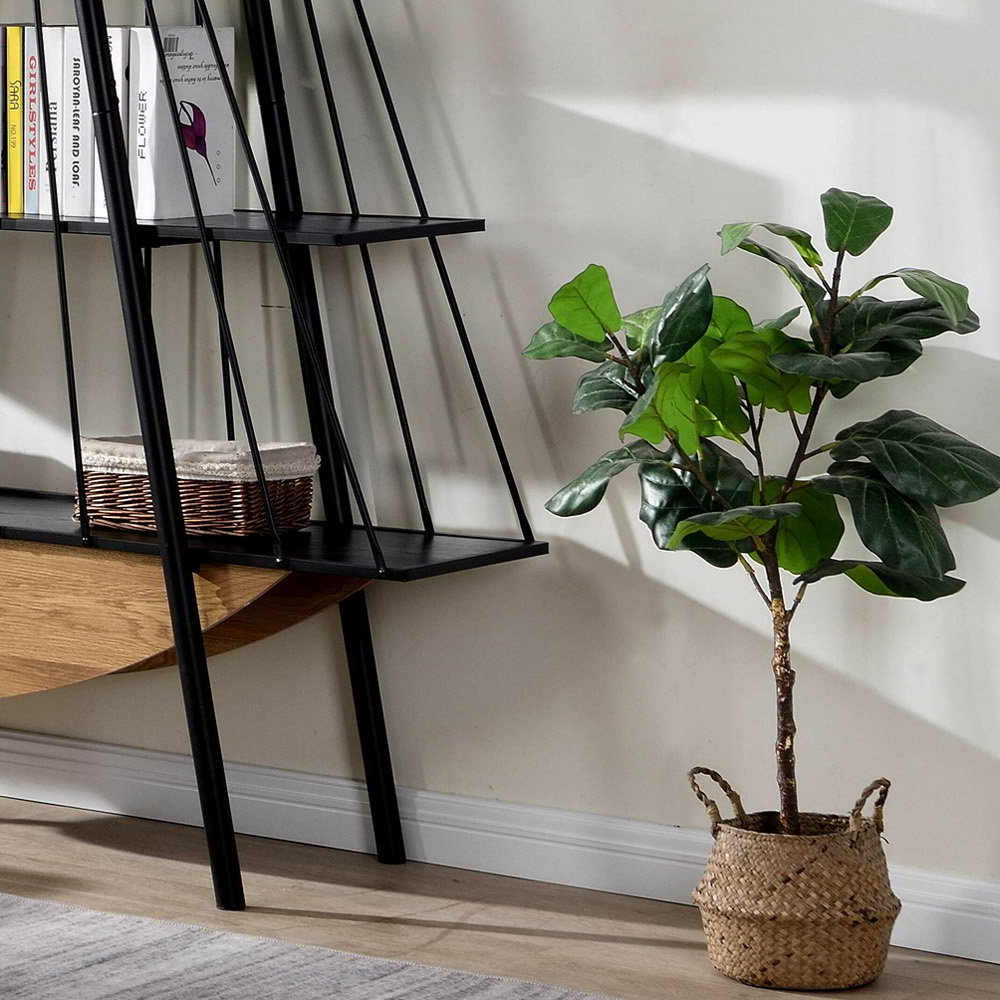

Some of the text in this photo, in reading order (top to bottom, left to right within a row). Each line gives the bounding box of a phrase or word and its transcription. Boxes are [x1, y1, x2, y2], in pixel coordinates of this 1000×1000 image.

[9, 79, 22, 111] SARA
[28, 55, 37, 191] GIRLSTYLES
[137, 91, 147, 160] FLOWER
[72, 138, 80, 162] AND
